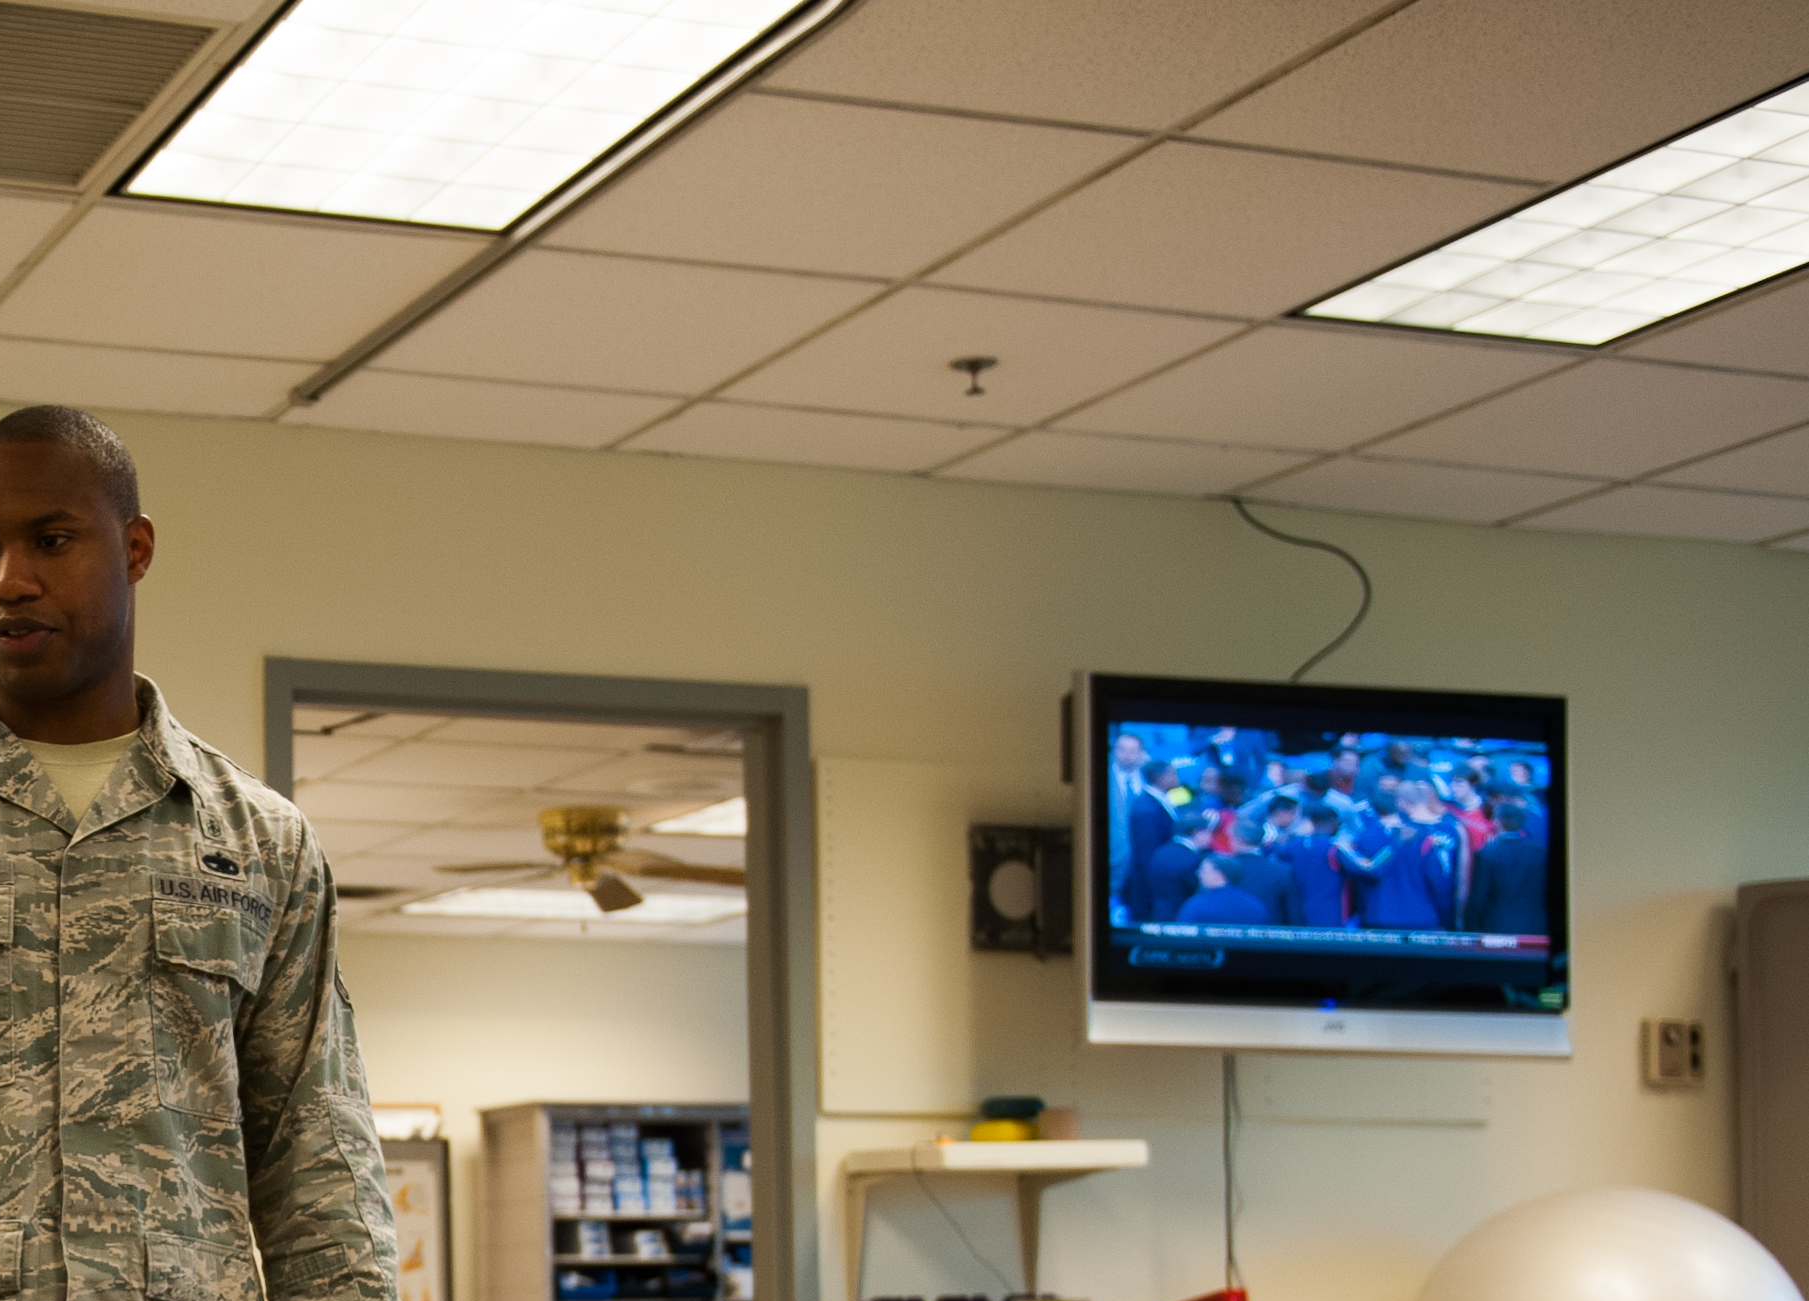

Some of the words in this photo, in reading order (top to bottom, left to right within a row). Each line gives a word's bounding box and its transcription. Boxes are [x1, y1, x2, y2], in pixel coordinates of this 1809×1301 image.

[160, 879, 197, 900] U.S.
[200, 885, 229, 905] AIR
[232, 892, 272, 926] FORCE
